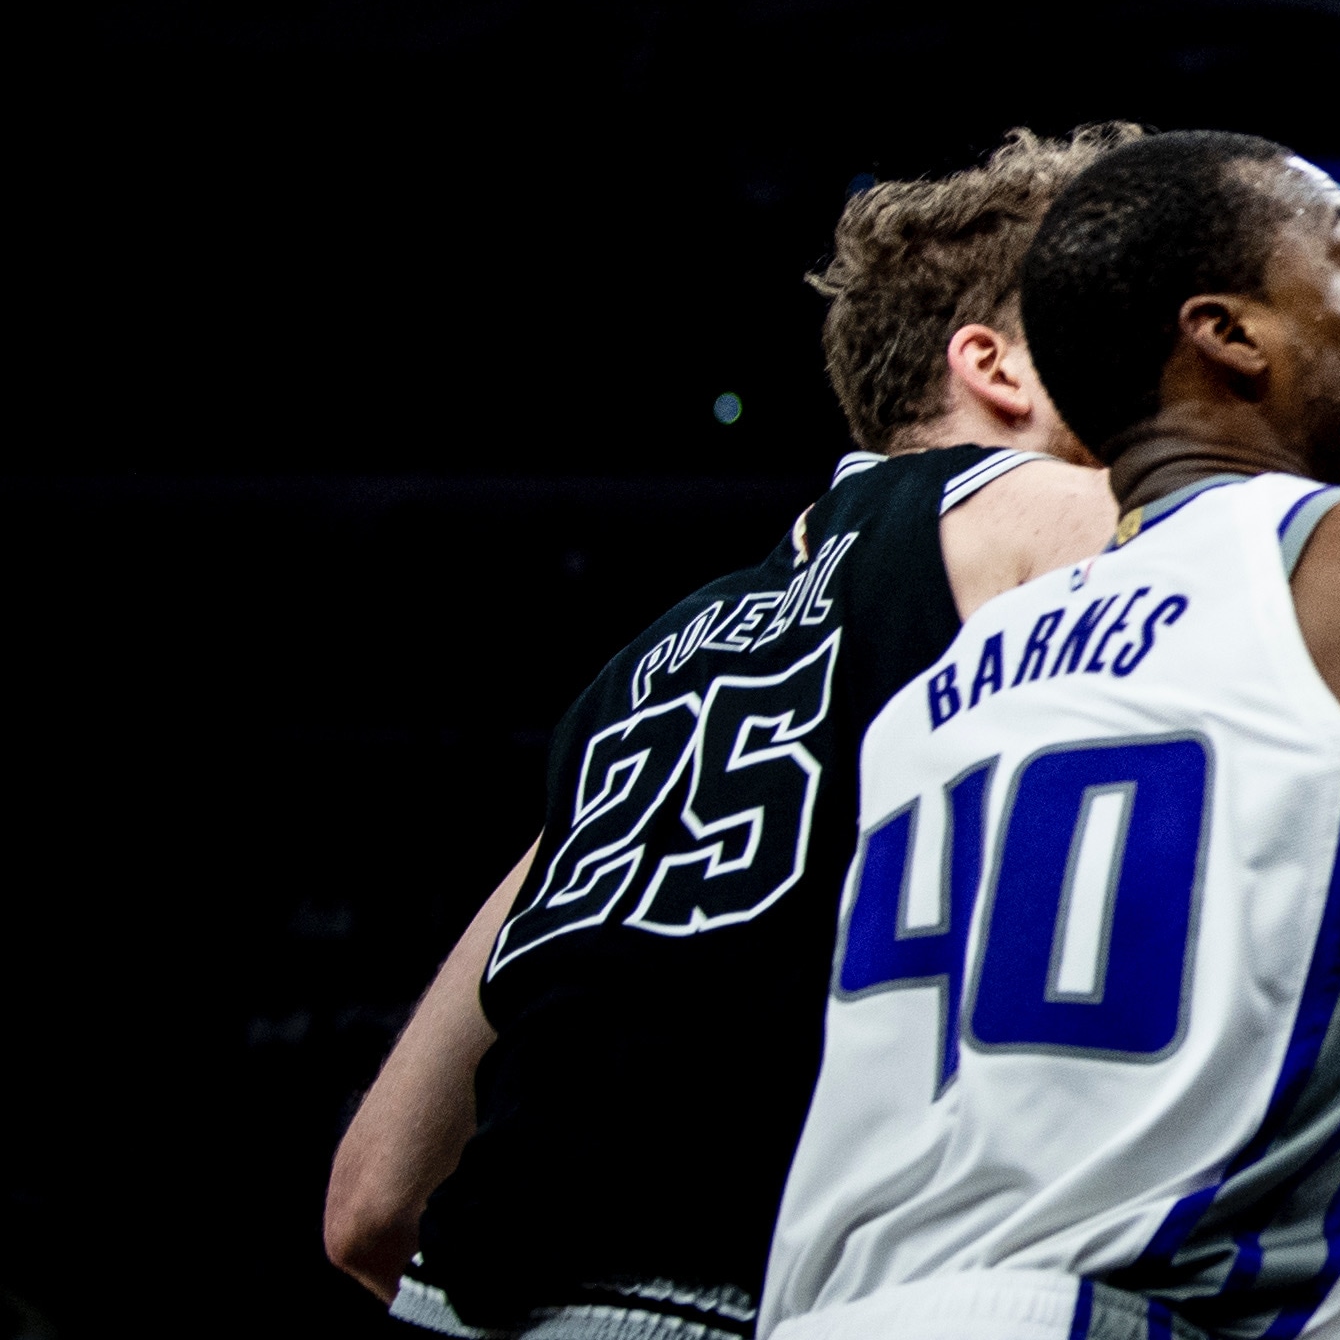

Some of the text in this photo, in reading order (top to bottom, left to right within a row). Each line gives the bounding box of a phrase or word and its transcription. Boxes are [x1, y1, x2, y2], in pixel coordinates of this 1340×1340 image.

[485, 626, 842, 984] 25
[927, 586, 1189, 732] BARNES
[832, 729, 1218, 1104] 40
